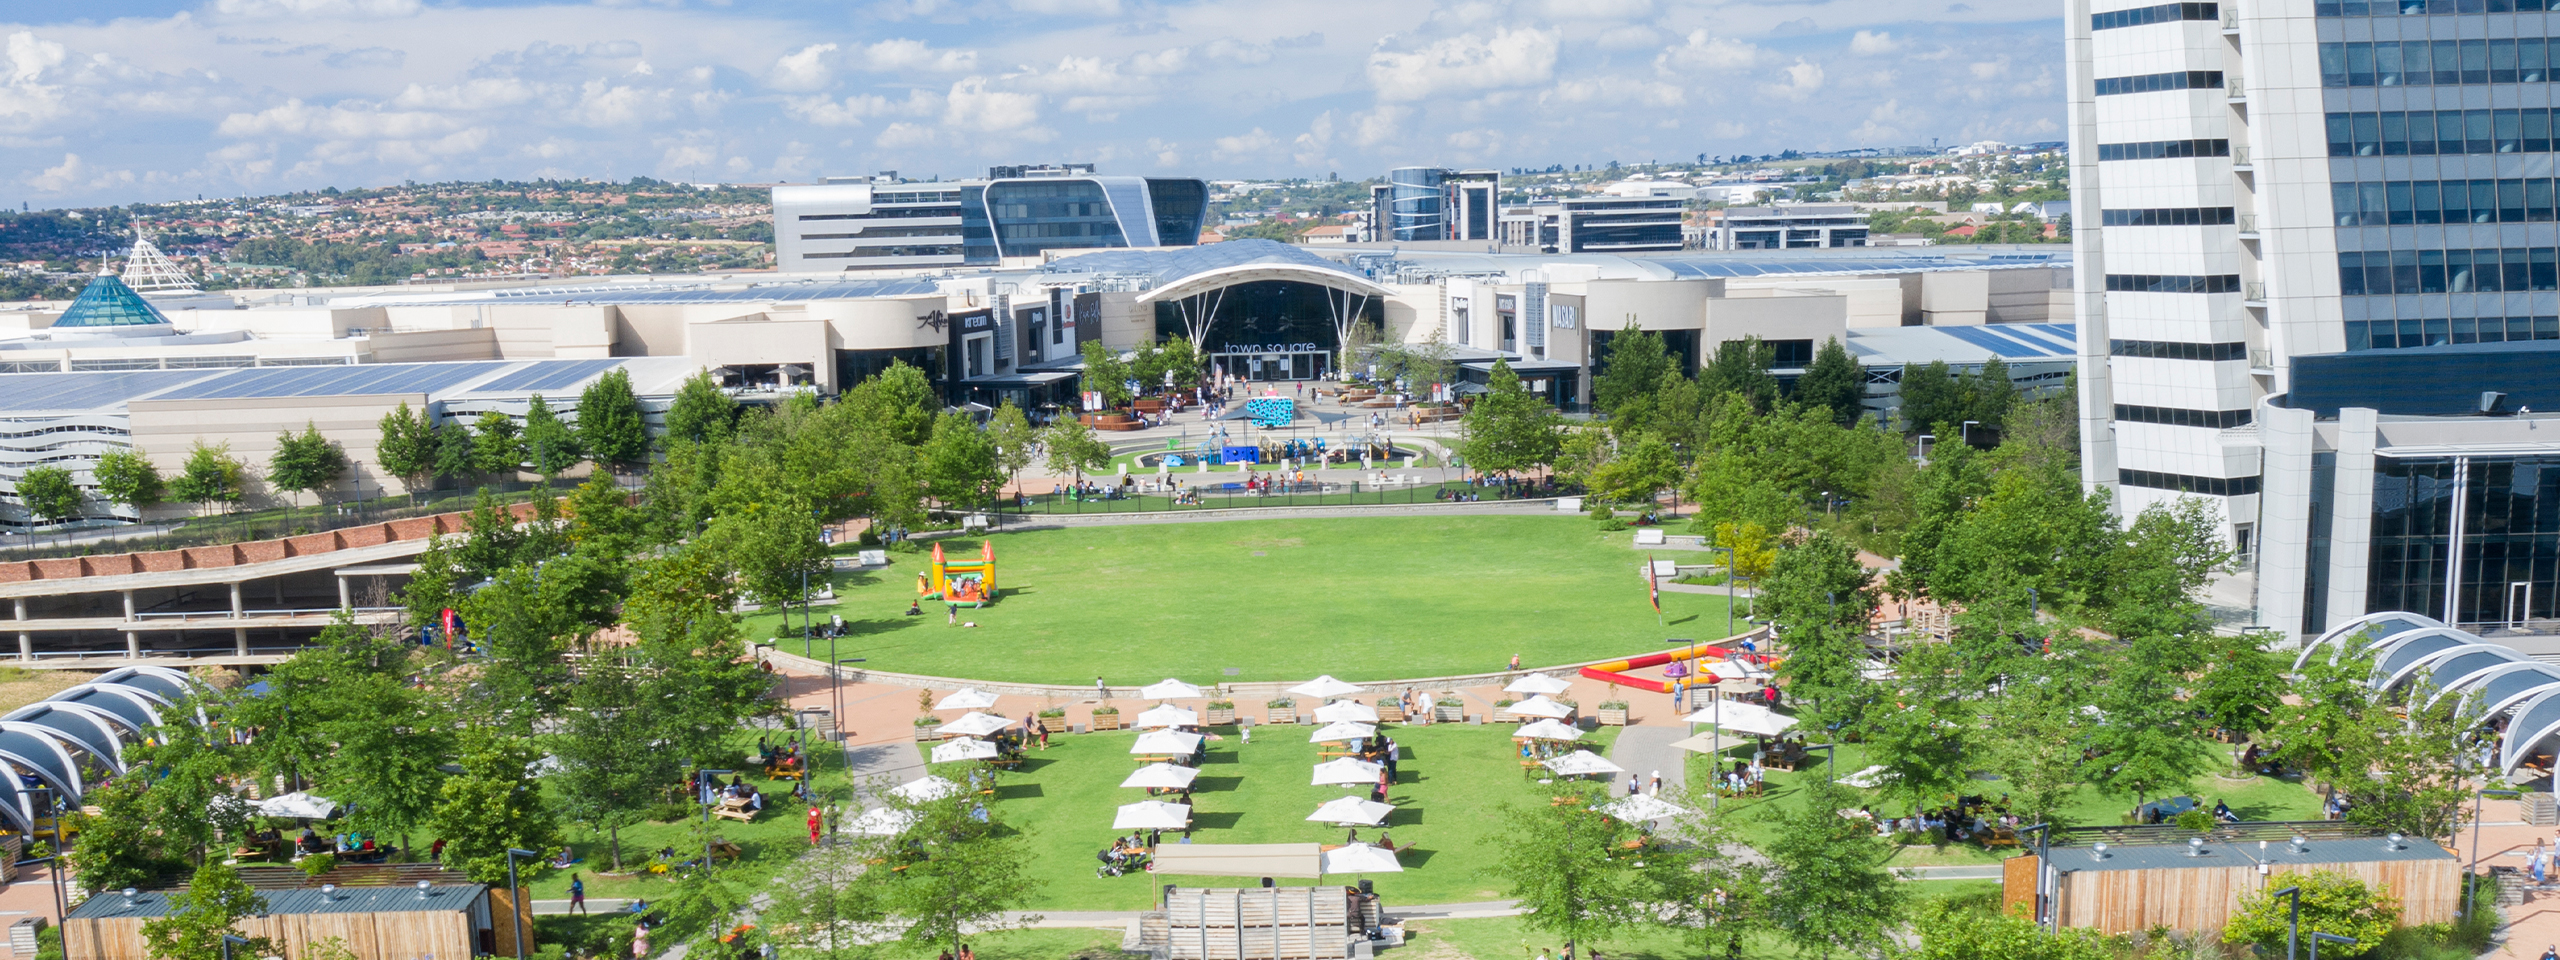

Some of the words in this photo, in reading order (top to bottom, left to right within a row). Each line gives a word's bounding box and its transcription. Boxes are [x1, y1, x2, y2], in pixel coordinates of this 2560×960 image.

[1552, 304, 1575, 330] WASABI
[1225, 341, 1262, 354] town
[1266, 342, 1316, 354] square
